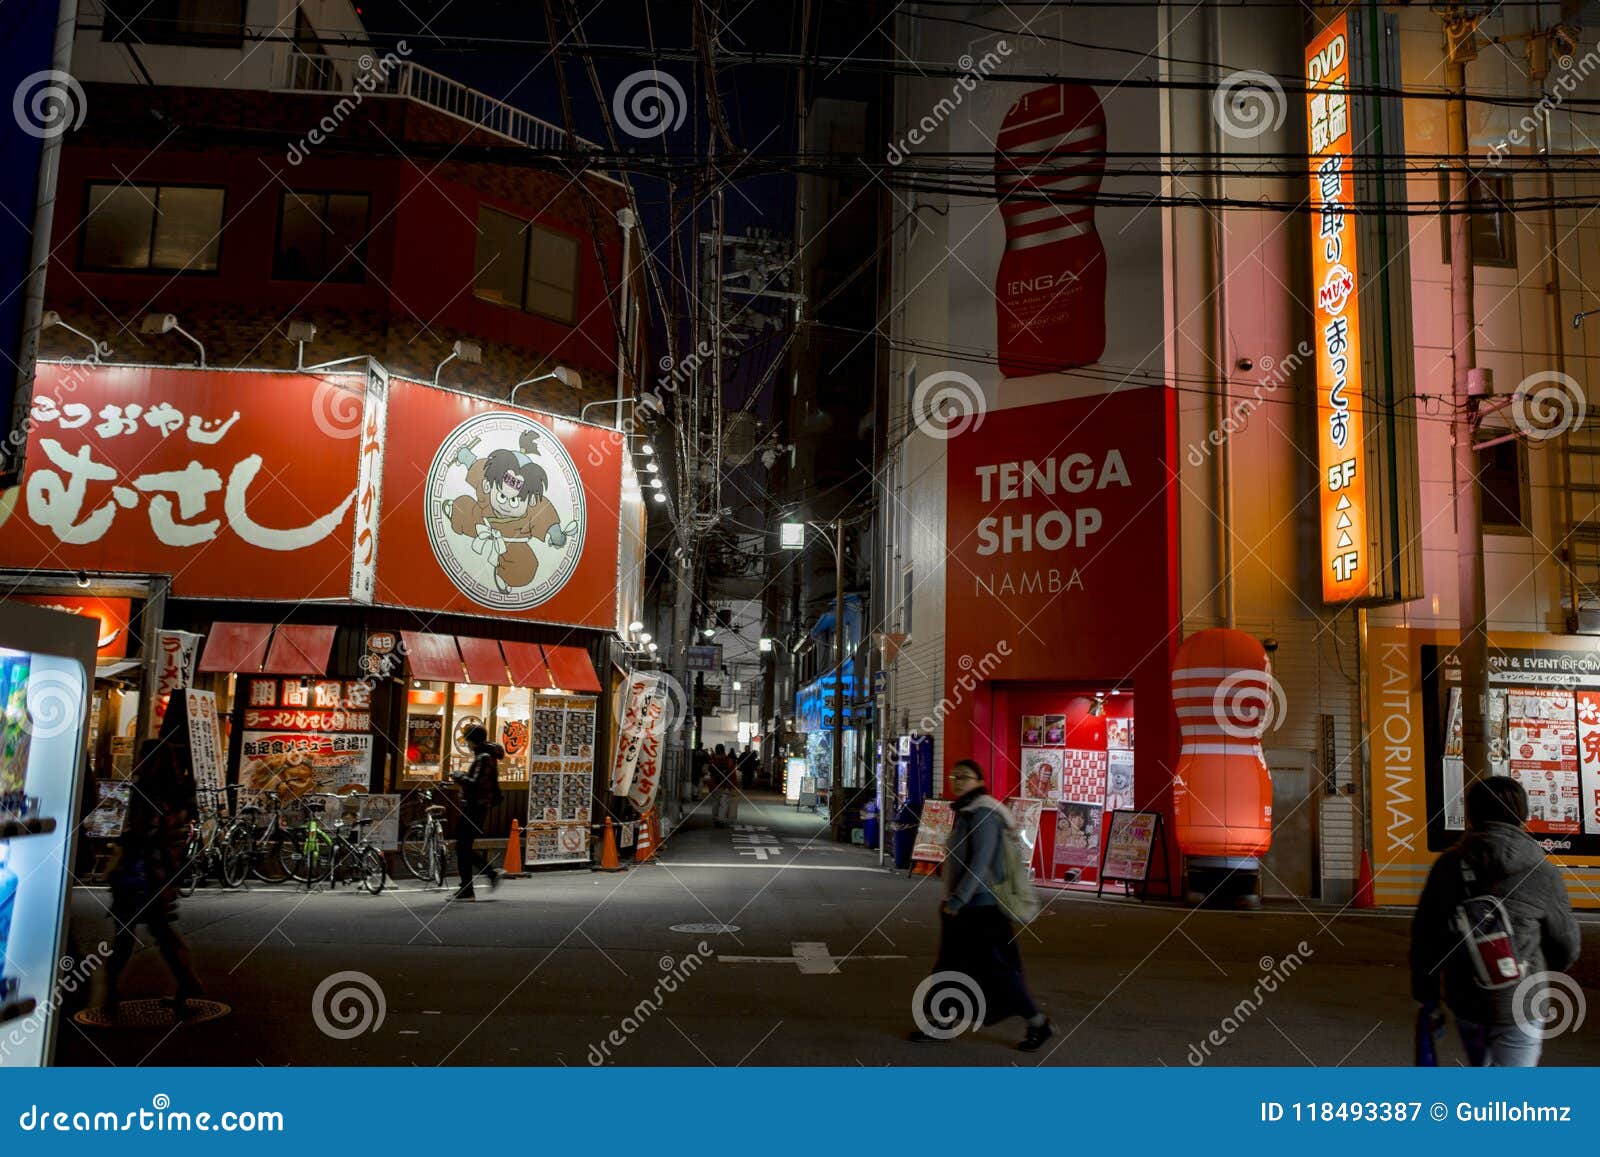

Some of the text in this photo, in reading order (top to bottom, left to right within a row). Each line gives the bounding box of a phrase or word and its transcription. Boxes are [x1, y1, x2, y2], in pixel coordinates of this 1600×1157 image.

[1308, 34, 1345, 90] DVD
[1318, 153, 1343, 262] 買取り
[1326, 316, 1348, 449] まっくす
[26, 438, 357, 550] むさし
[975, 449, 1132, 502] TENGA
[1328, 459, 1356, 491] 5F
[976, 507, 1102, 556] SHOP
[975, 568, 1084, 597] NAMBA
[1332, 551, 1358, 582] 1F
[1524, 657, 1557, 670] EVENT
[252, 680, 371, 709] 期間限定
[1382, 643, 1415, 851] KAITORIMAX
